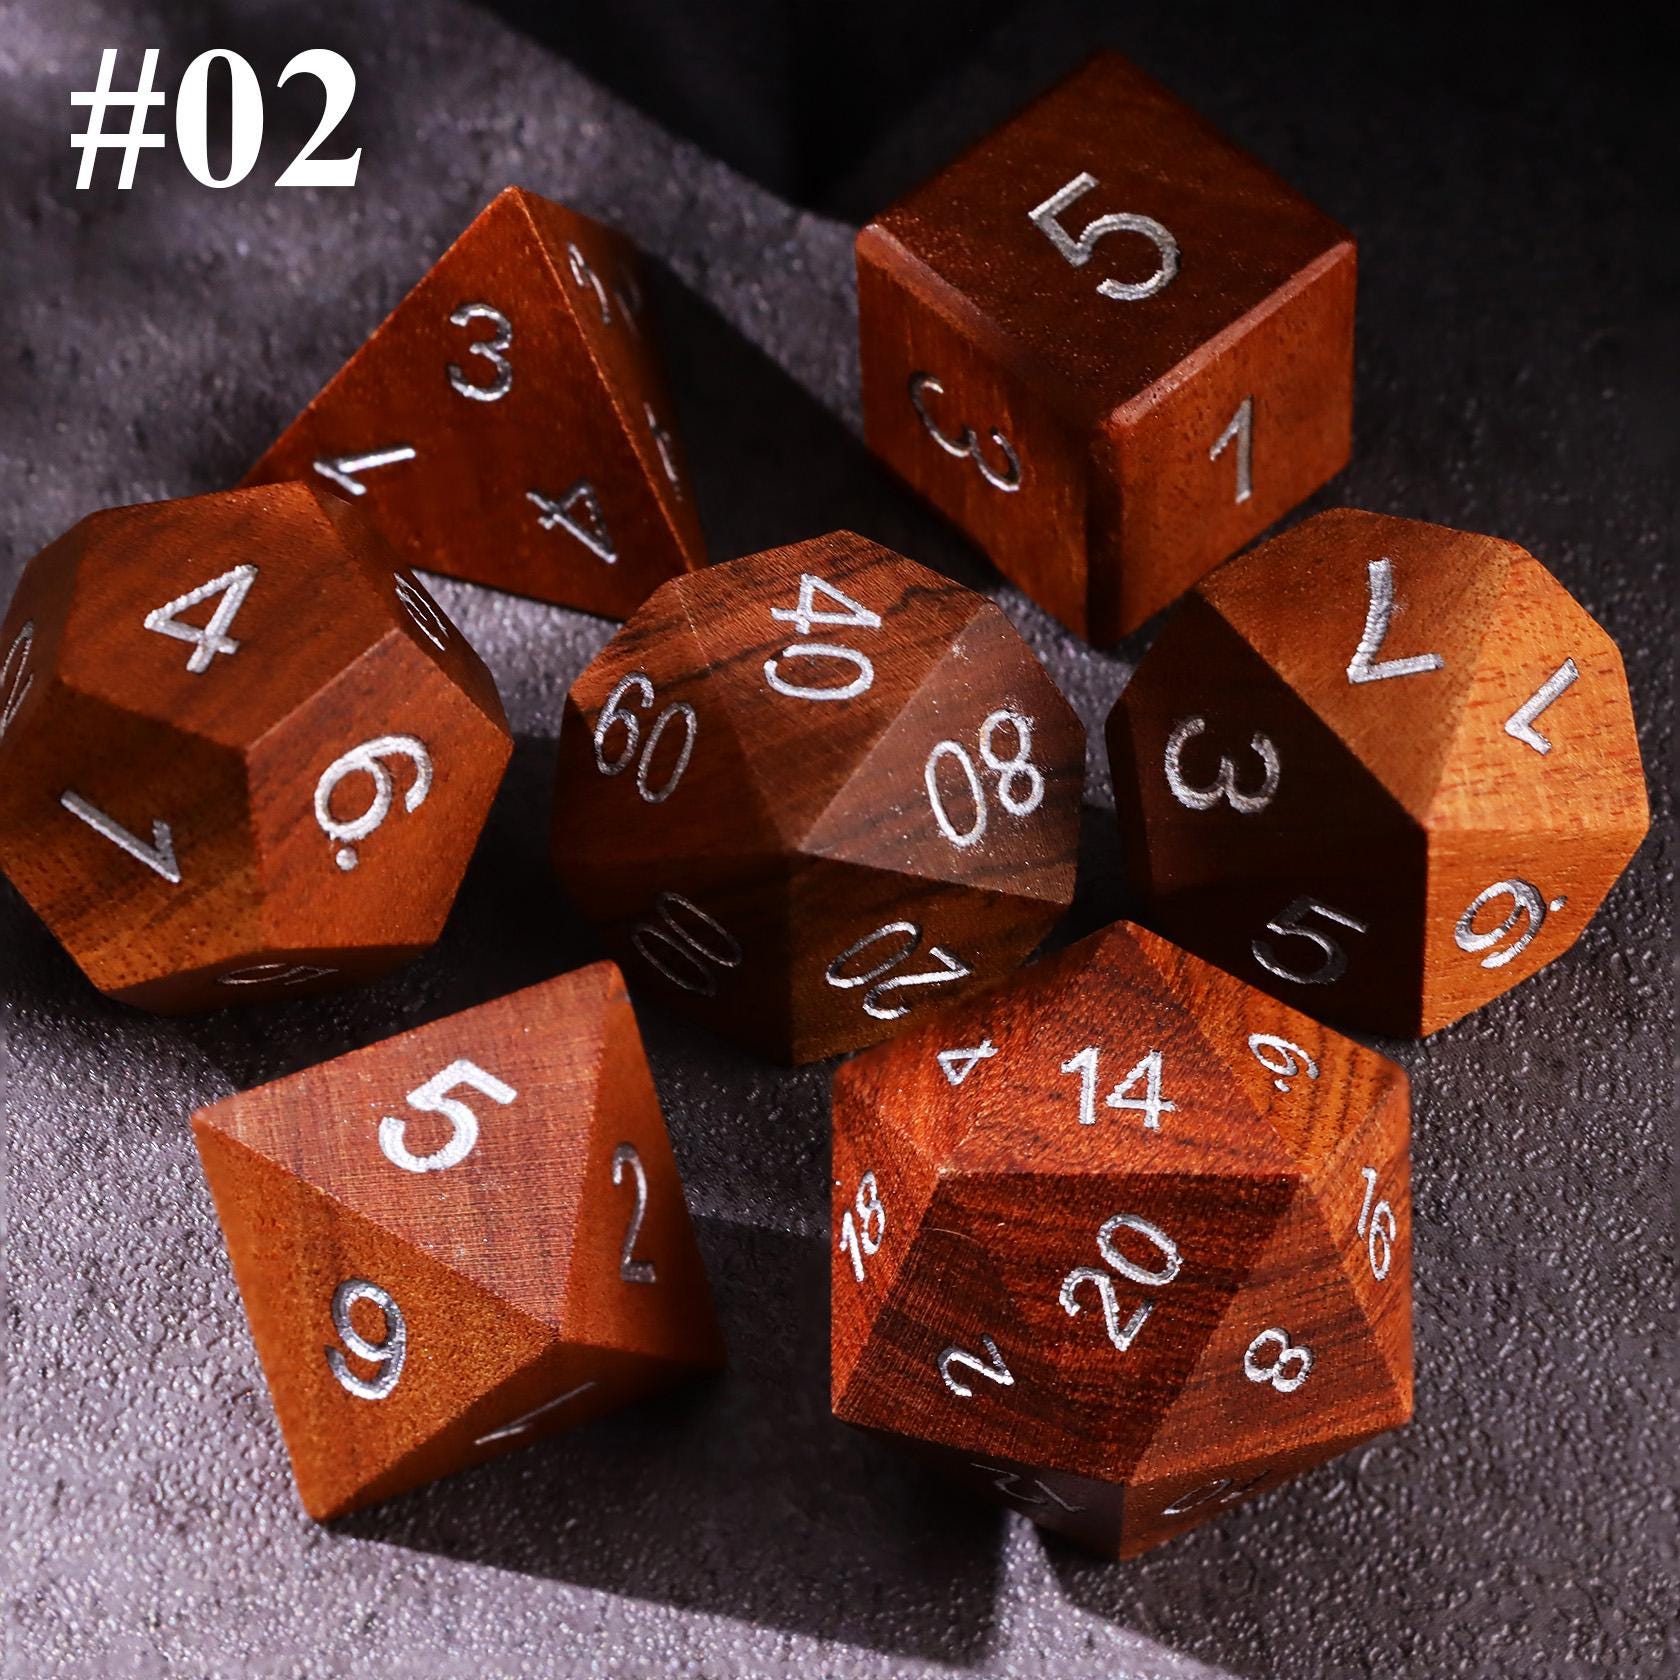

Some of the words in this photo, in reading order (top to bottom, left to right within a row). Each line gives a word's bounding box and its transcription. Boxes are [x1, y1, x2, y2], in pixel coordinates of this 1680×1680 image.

[1028, 172, 1178, 301] 5
[450, 305, 512, 401] 3
[312, 446, 418, 497] 1
[906, 374, 1022, 494] 3
[1210, 401, 1251, 503] 1
[524, 484, 619, 566] 4
[144, 565, 257, 672] 4
[764, 574, 882, 700] 40
[1347, 558, 1443, 683] 7
[593, 672, 698, 803] 60
[1505, 659, 1578, 753] 1
[925, 710, 1044, 852] 80
[1165, 719, 1279, 812] 3
[60, 790, 181, 884] 1
[826, 922, 970, 1019] 20
[1252, 897, 1368, 985] 5
[937, 1040, 998, 1085] 4
[1061, 1046, 1175, 1132] 14
[379, 1060, 517, 1173] 5
[611, 1144, 657, 1284] 2
[837, 1171, 886, 1283] 18
[1357, 1167, 1397, 1281] 16
[1059, 1216, 1183, 1352] 20
[939, 1334, 1014, 1399] 2
[1244, 1328, 1311, 1392] 8
